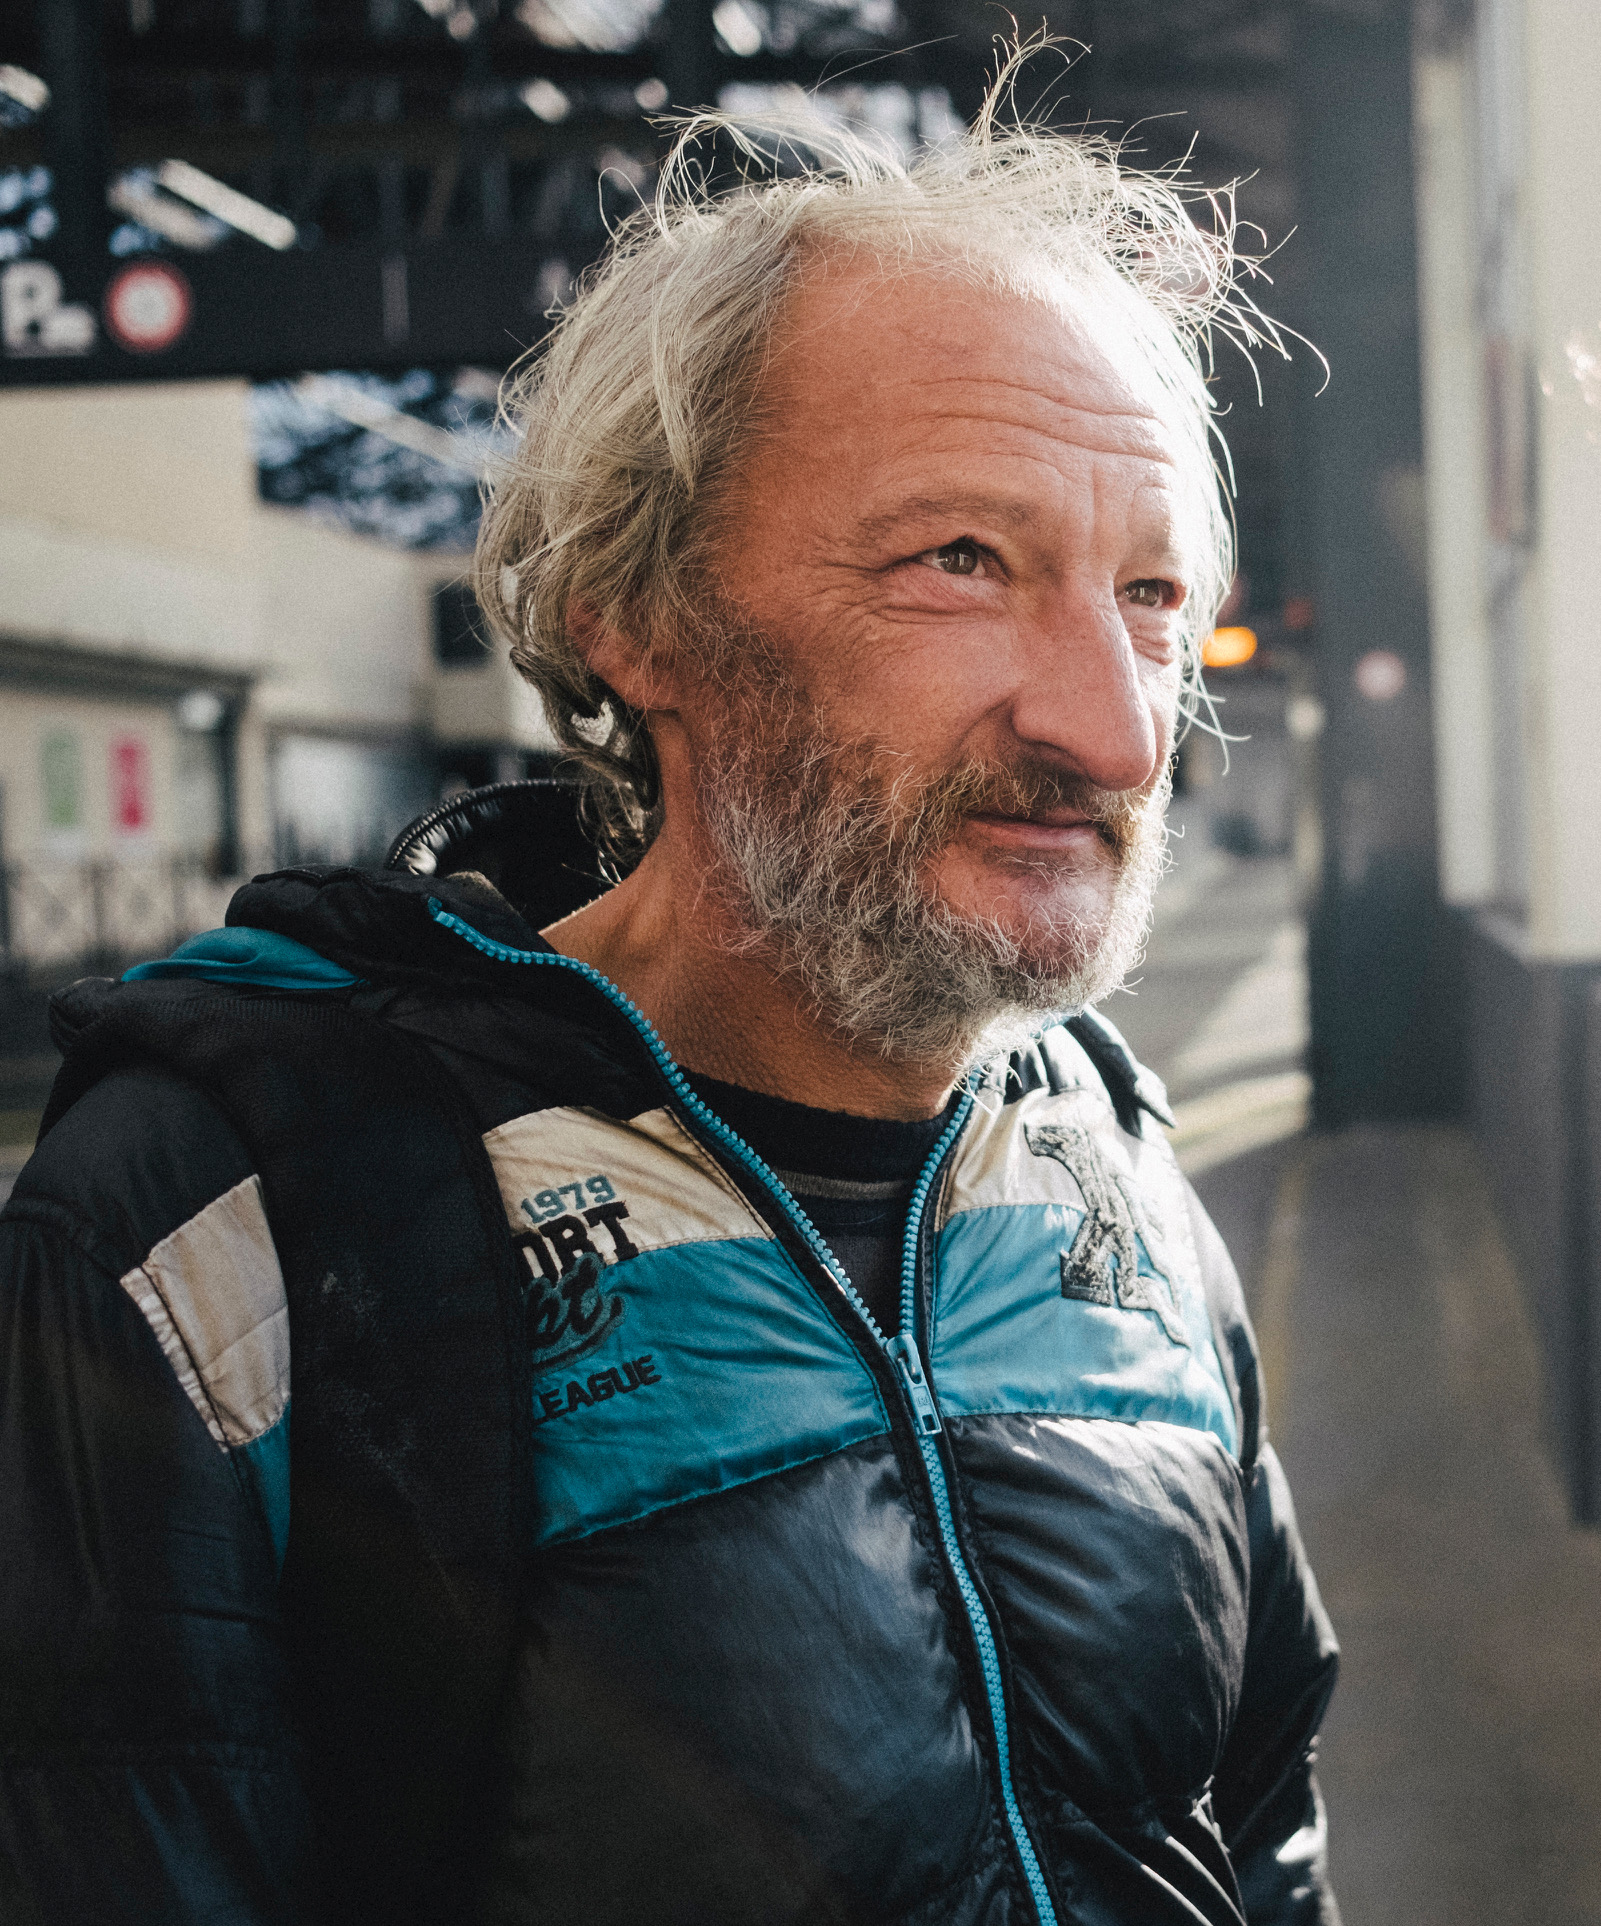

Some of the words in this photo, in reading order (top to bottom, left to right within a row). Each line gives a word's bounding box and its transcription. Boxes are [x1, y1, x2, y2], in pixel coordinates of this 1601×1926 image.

[520, 1174, 617, 1224] 1979
[512, 1200, 640, 1289] ORT
[535, 1354, 662, 1425] EAGUE
